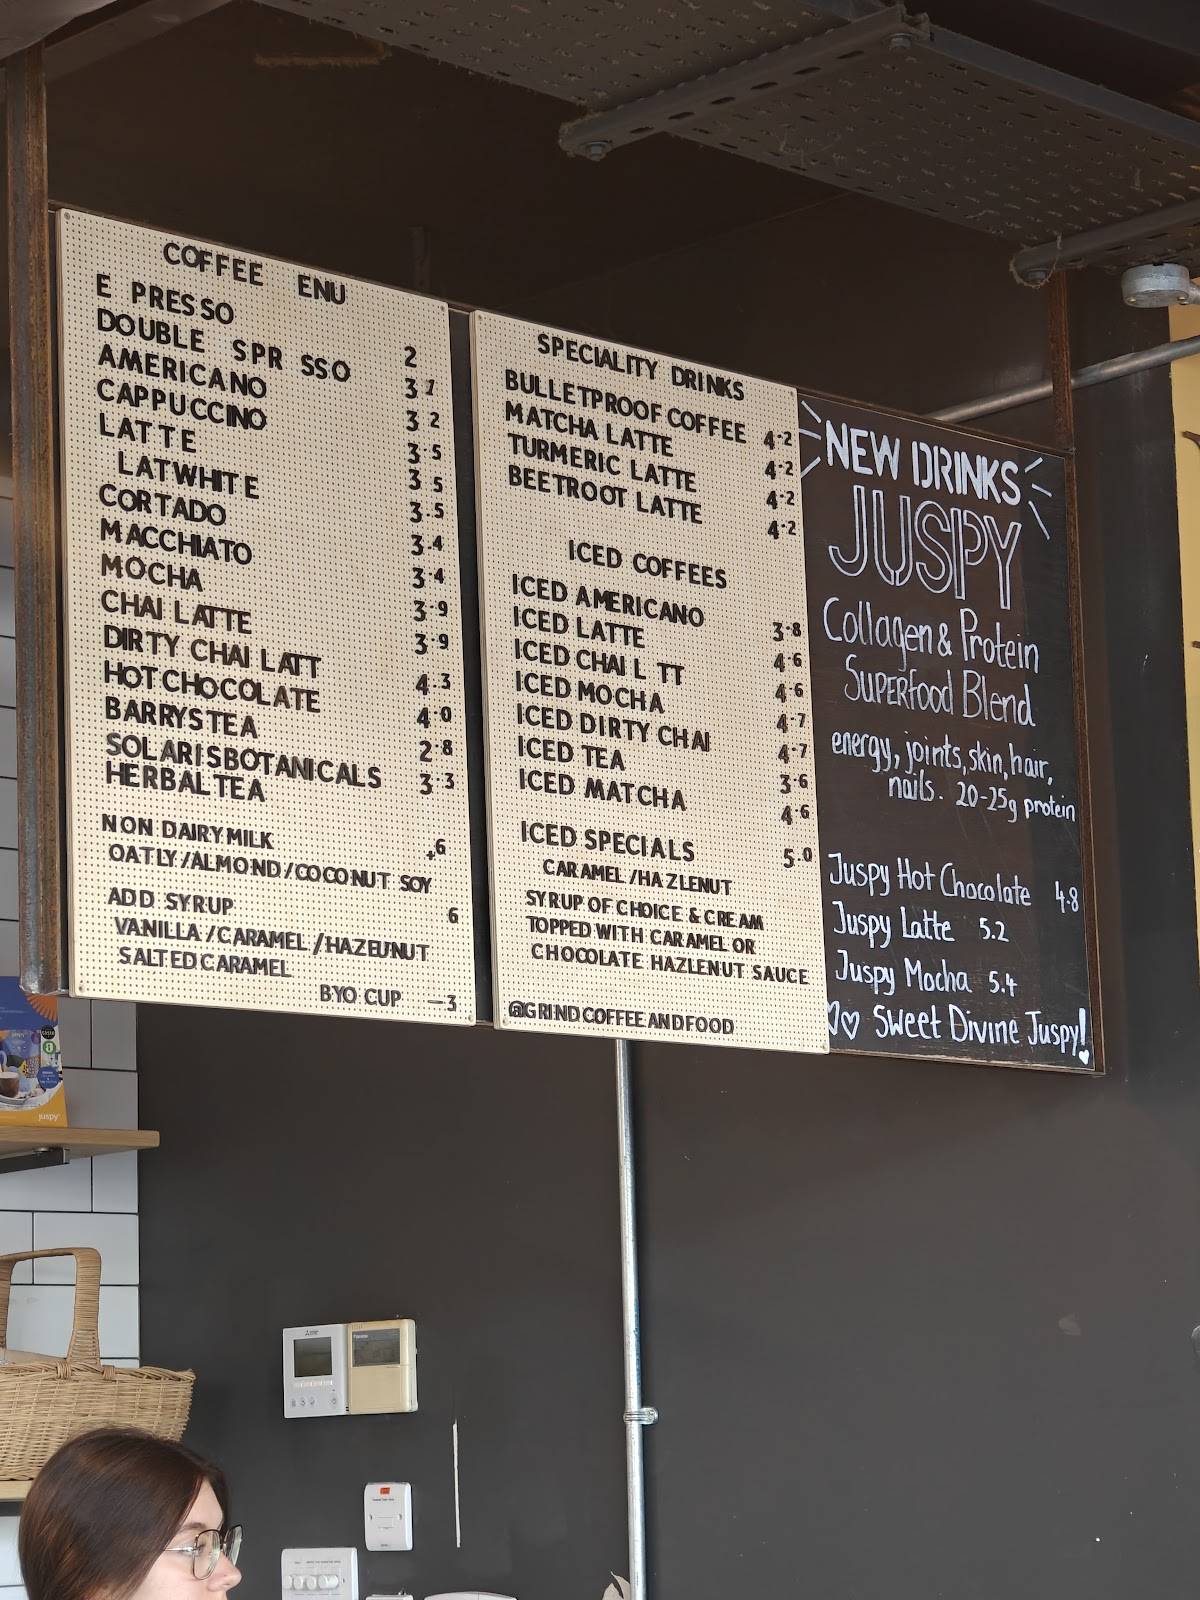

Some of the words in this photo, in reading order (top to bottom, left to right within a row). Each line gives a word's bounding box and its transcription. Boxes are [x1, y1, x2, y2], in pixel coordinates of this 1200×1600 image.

[163, 242, 264, 286] COFFEE
[297, 274, 347, 305] ENU
[97, 308, 205, 353] DOUBLE
[404, 346, 417, 368] 2
[98, 344, 267, 399] AMERICANO
[538, 333, 658, 380] SPECIALITY
[671, 365, 744, 400] DRINKS
[98, 379, 267, 431] CAPPUCCINO
[505, 369, 661, 423] BULLETPROOF
[667, 407, 747, 444] COFFEE
[505, 400, 599, 440] MATCHA
[606, 423, 673, 457] LATTE
[100, 412, 196, 453] LATTE
[508, 432, 621, 477] TURMERIC
[631, 459, 697, 493] LATTE
[826, 419, 900, 480] NEW
[912, 440, 1021, 506] DRINKS
[100, 484, 226, 526] CORTADO
[508, 464, 627, 508] BEETROOT
[636, 491, 702, 525] LATTE
[100, 518, 252, 565] MACCHIATO
[569, 540, 622, 569] ICED
[633, 553, 727, 589] COFFEES
[828, 484, 1022, 611] JUSPY
[101, 553, 203, 591] MOCHA
[101, 590, 162, 620] CHAI
[174, 600, 252, 634] LATTE
[512, 574, 568, 602] ICED
[576, 586, 705, 627] AMERICANO
[104, 625, 179, 657] DIRTY
[190, 639, 250, 668] CHAI
[261, 649, 321, 678] LATT
[513, 606, 569, 634] ICED
[577, 617, 645, 649] LATTE
[823, 596, 933, 671] Collagen
[937, 622, 952, 657] &
[960, 607, 1039, 674] Protein
[514, 638, 570, 667] ICED
[576, 649, 625, 677] CHAI
[515, 670, 571, 699] ICED
[578, 680, 665, 714] MOCHA
[963, 669, 1036, 727] Blend
[517, 702, 573, 731] ICED
[580, 712, 650, 743] DIRTY
[657, 725, 710, 752] CHAI
[518, 735, 574, 763] ICED
[581, 744, 625, 771] TEA
[519, 767, 575, 795] ICED
[584, 777, 687, 811] MATCHA
[1025, 795, 1075, 822] protein
[102, 813, 153, 836] NON
[520, 820, 578, 848] ICED
[584, 828, 695, 862] SPECIALS
[107, 887, 155, 909] ADD
[166, 892, 234, 915] SYRUP
[448, 907, 459, 924] 6
[400, 874, 432, 894] SOY
[828, 852, 889, 897] Juspy
[897, 857, 935, 891] Hot
[940, 862, 1032, 906] Chocolate
[1055, 880, 1079, 913] 4.8
[526, 889, 584, 912] SYRUP
[588, 896, 613, 915] OF
[616, 899, 682, 922] CHOICE
[688, 907, 700, 923] &
[704, 909, 764, 930] CREAM
[832, 900, 892, 948] Juspy
[901, 906, 955, 942] Latte
[980, 917, 1009, 942] 5.2
[526, 915, 592, 939] TOPPED
[596, 922, 644, 944] WITH
[650, 928, 728, 951] CARAMEL
[732, 938, 756, 955] OR
[531, 943, 645, 969] CHOCOLATE
[650, 954, 746, 979] HAZLENUT
[752, 965, 810, 985] SAUCE
[835, 949, 895, 996] Juspy
[904, 957, 972, 993] Mocha
[989, 970, 1017, 997] 5.4
[320, 984, 358, 1004] BYO
[364, 988, 402, 1007] CUP
[873, 1004, 941, 1040] Sweet
[949, 1003, 1019, 1044] Divine
[1025, 1007, 1086, 1056] Juspy!
